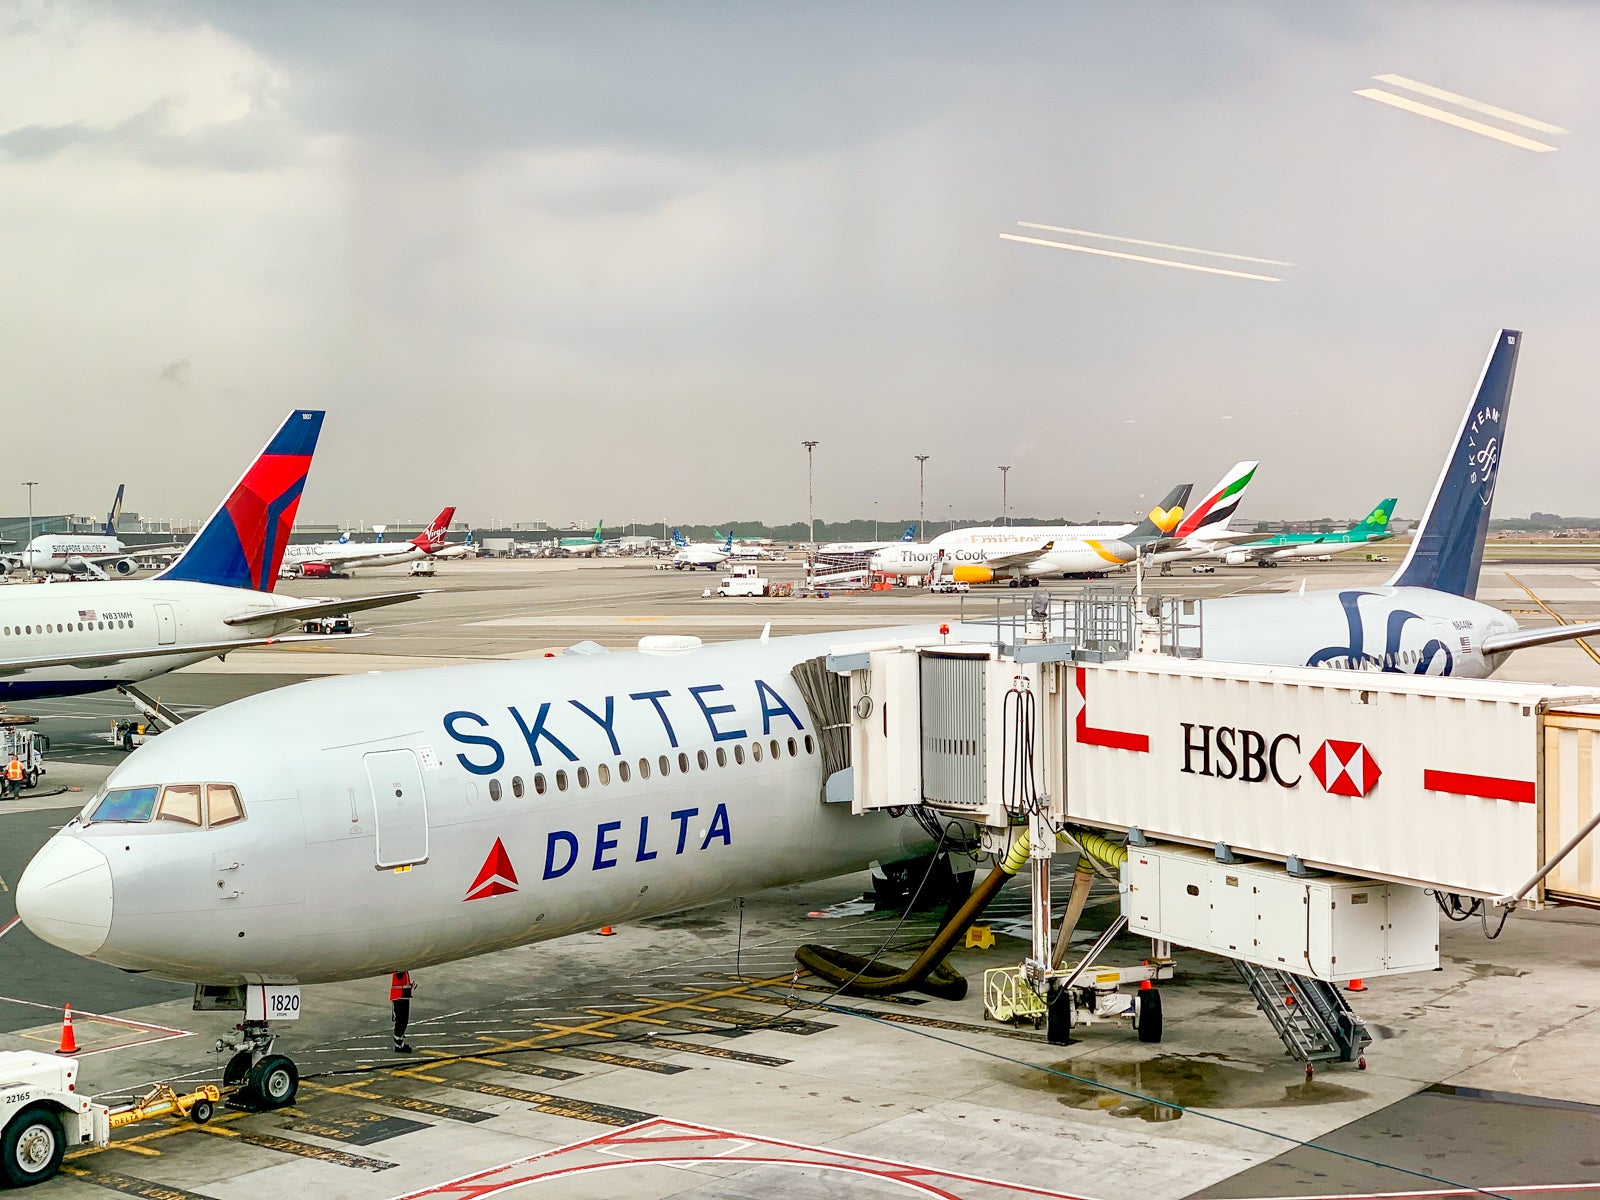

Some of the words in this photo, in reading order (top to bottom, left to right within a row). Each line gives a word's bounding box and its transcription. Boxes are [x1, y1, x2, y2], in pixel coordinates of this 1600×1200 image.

[1469, 406, 1500, 484] SKYTEAM
[425, 521, 447, 543] Virgin
[970, 534, 1041, 543] Emirates
[955, 548, 988, 561] Cook
[102, 611, 133, 620] N831MH
[1180, 722, 1302, 789] HSBC
[542, 803, 733, 881] DELTA
[270, 994, 300, 1012] 1820
[6, 1091, 30, 1104] 22165
[114, 1114, 139, 1125] DELTA
